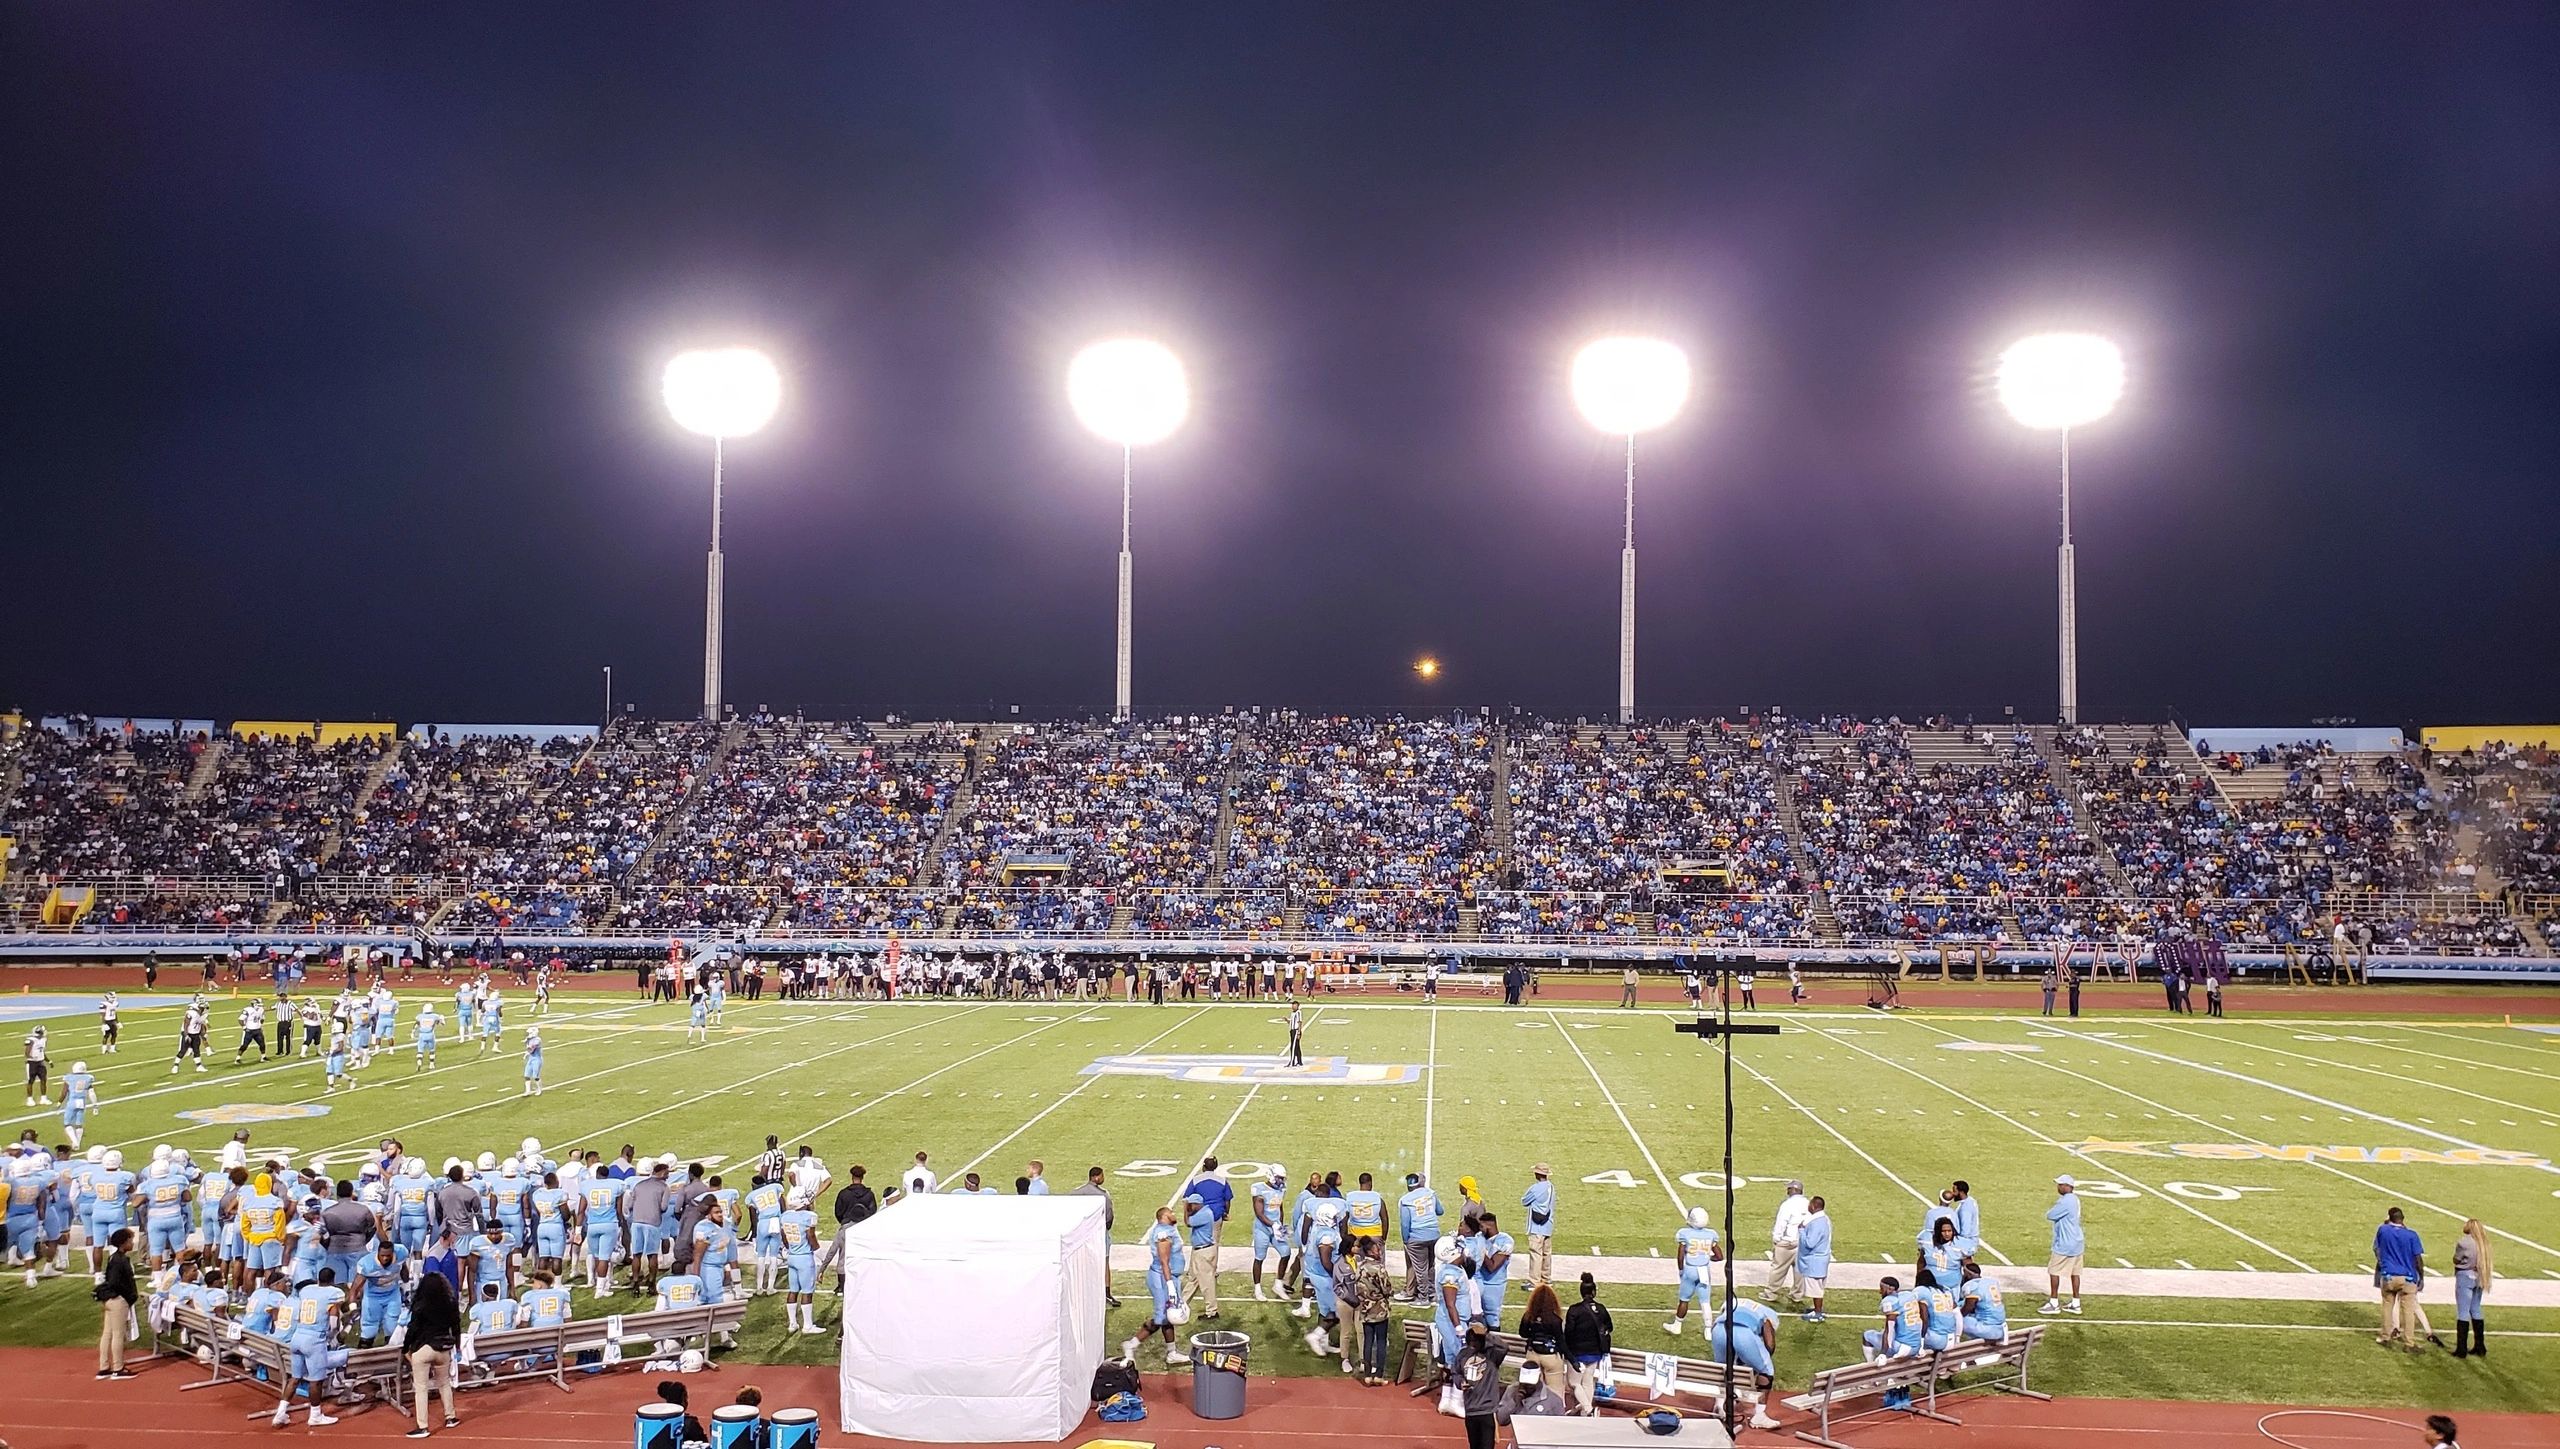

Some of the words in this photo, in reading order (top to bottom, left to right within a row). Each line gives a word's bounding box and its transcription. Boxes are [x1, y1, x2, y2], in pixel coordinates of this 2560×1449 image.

[775, 1156, 783, 1170] 5
[2170, 1143, 2551, 1166] SWAC
[1113, 1160, 1269, 1178] 50
[1581, 1169, 1747, 1190] 40
[96, 1182, 118, 1202] 90
[589, 1187, 613, 1209] 97
[2073, 1180, 2242, 1200] 30
[538, 1297, 560, 1318] 12
